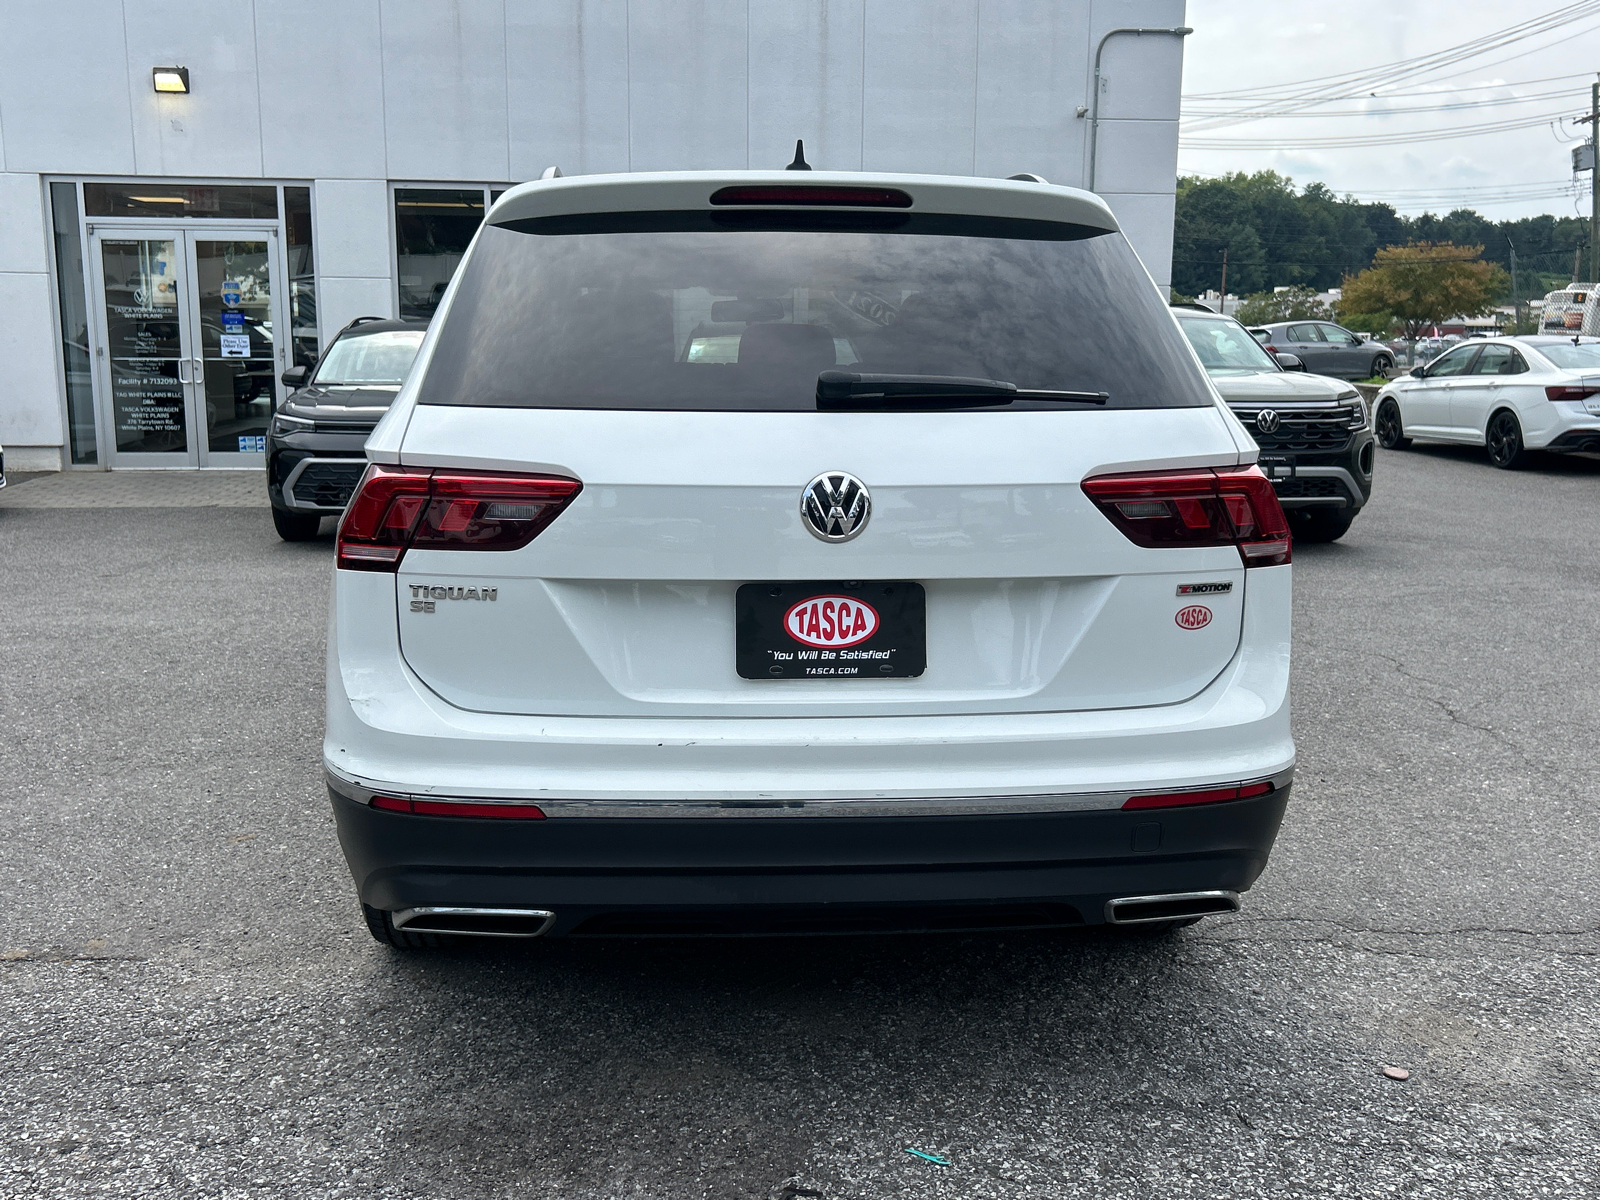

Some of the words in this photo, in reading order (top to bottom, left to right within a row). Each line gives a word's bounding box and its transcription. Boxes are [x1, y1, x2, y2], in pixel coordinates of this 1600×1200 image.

[408, 583, 498, 601] TIGUAN
[410, 600, 436, 613] SE
[794, 600, 868, 642] TASCA
[1180, 608, 1208, 627] TASCA
[797, 650, 818, 660] Will
[820, 650, 837, 660] Be
[805, 667, 859, 675] TASCA.COM
